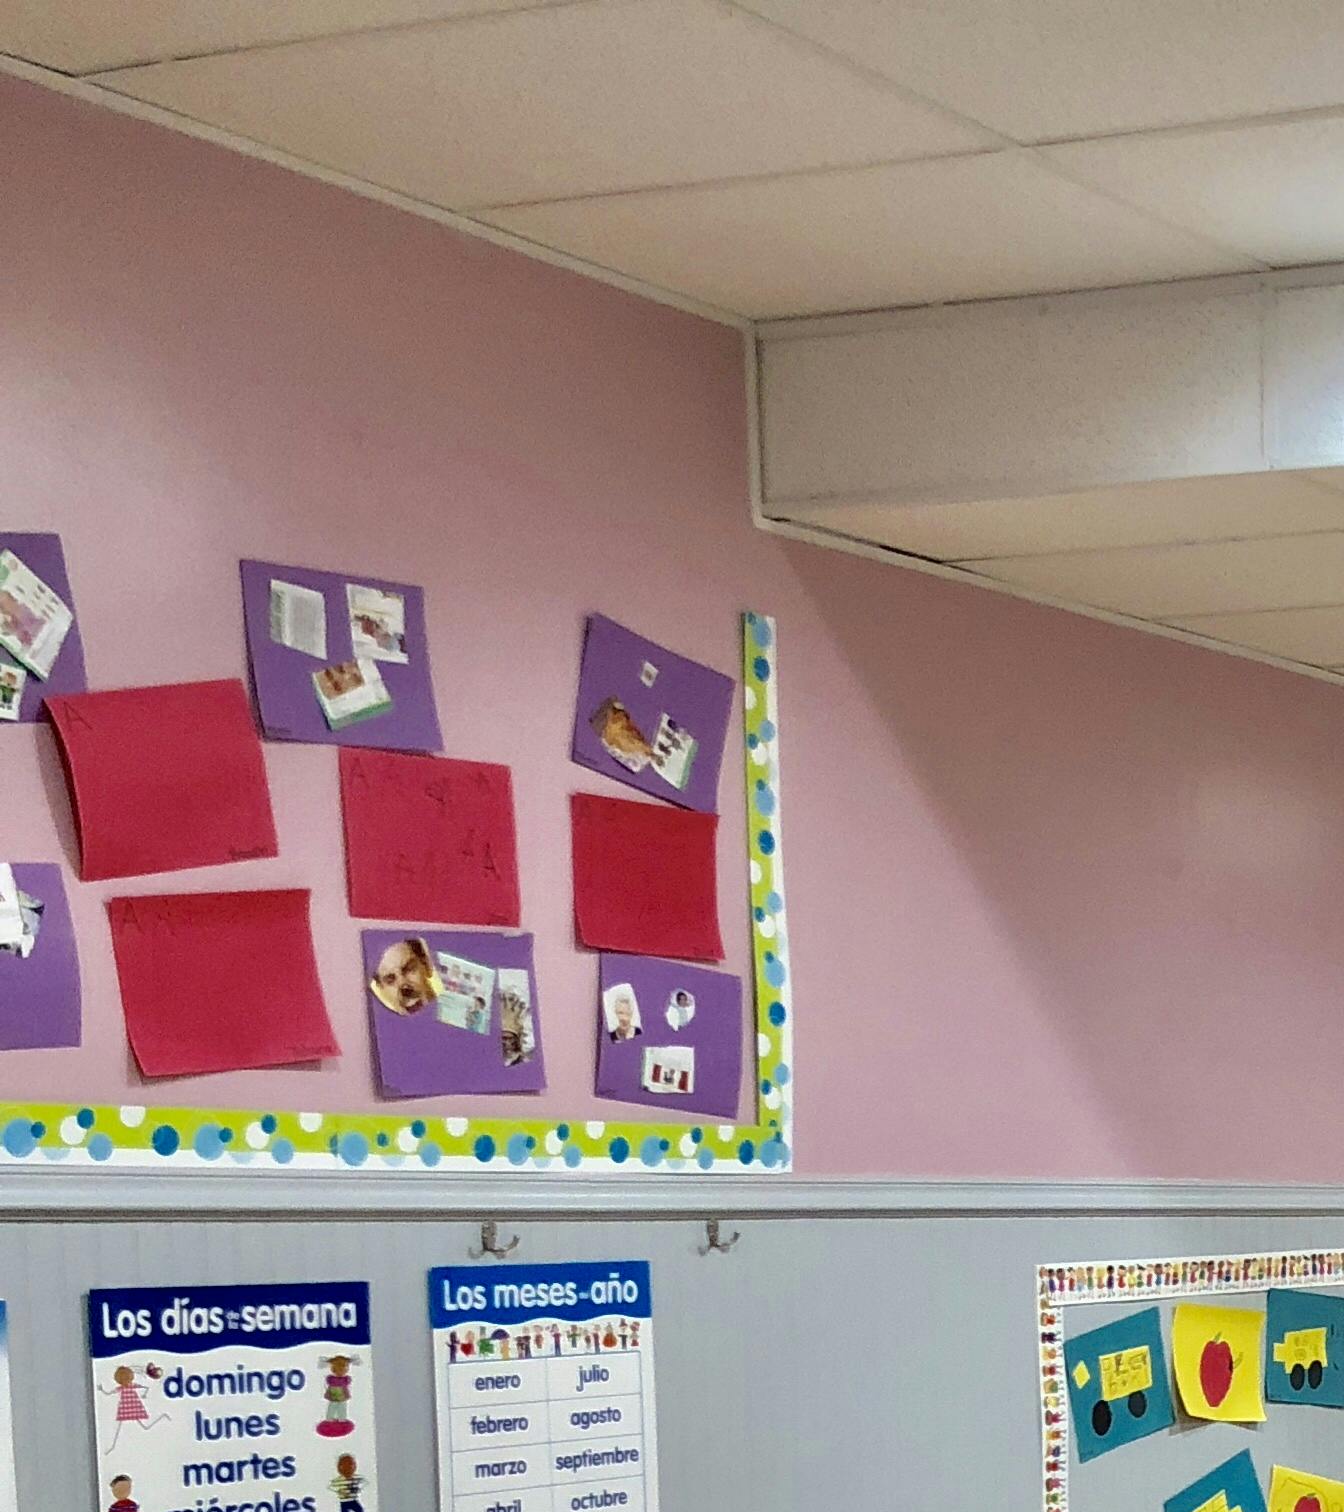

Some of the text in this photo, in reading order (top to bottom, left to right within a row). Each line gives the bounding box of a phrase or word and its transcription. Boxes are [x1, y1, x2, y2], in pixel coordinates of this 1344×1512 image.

[443, 1272, 639, 1311] Los meses año
[102, 1301, 152, 1338] Los
[161, 1297, 224, 1336] días
[241, 1302, 358, 1333] semana
[163, 1364, 305, 1400] domingo
[474, 1374, 521, 1392] enero
[575, 1364, 609, 1391] julio
[195, 1410, 281, 1441] lunes
[469, 1415, 529, 1435] febrero
[570, 1406, 622, 1430] agosto
[183, 1453, 296, 1487] martes
[474, 1460, 527, 1478] marzo
[555, 1446, 639, 1473] septiembre
[570, 1489, 628, 1511] octubre
